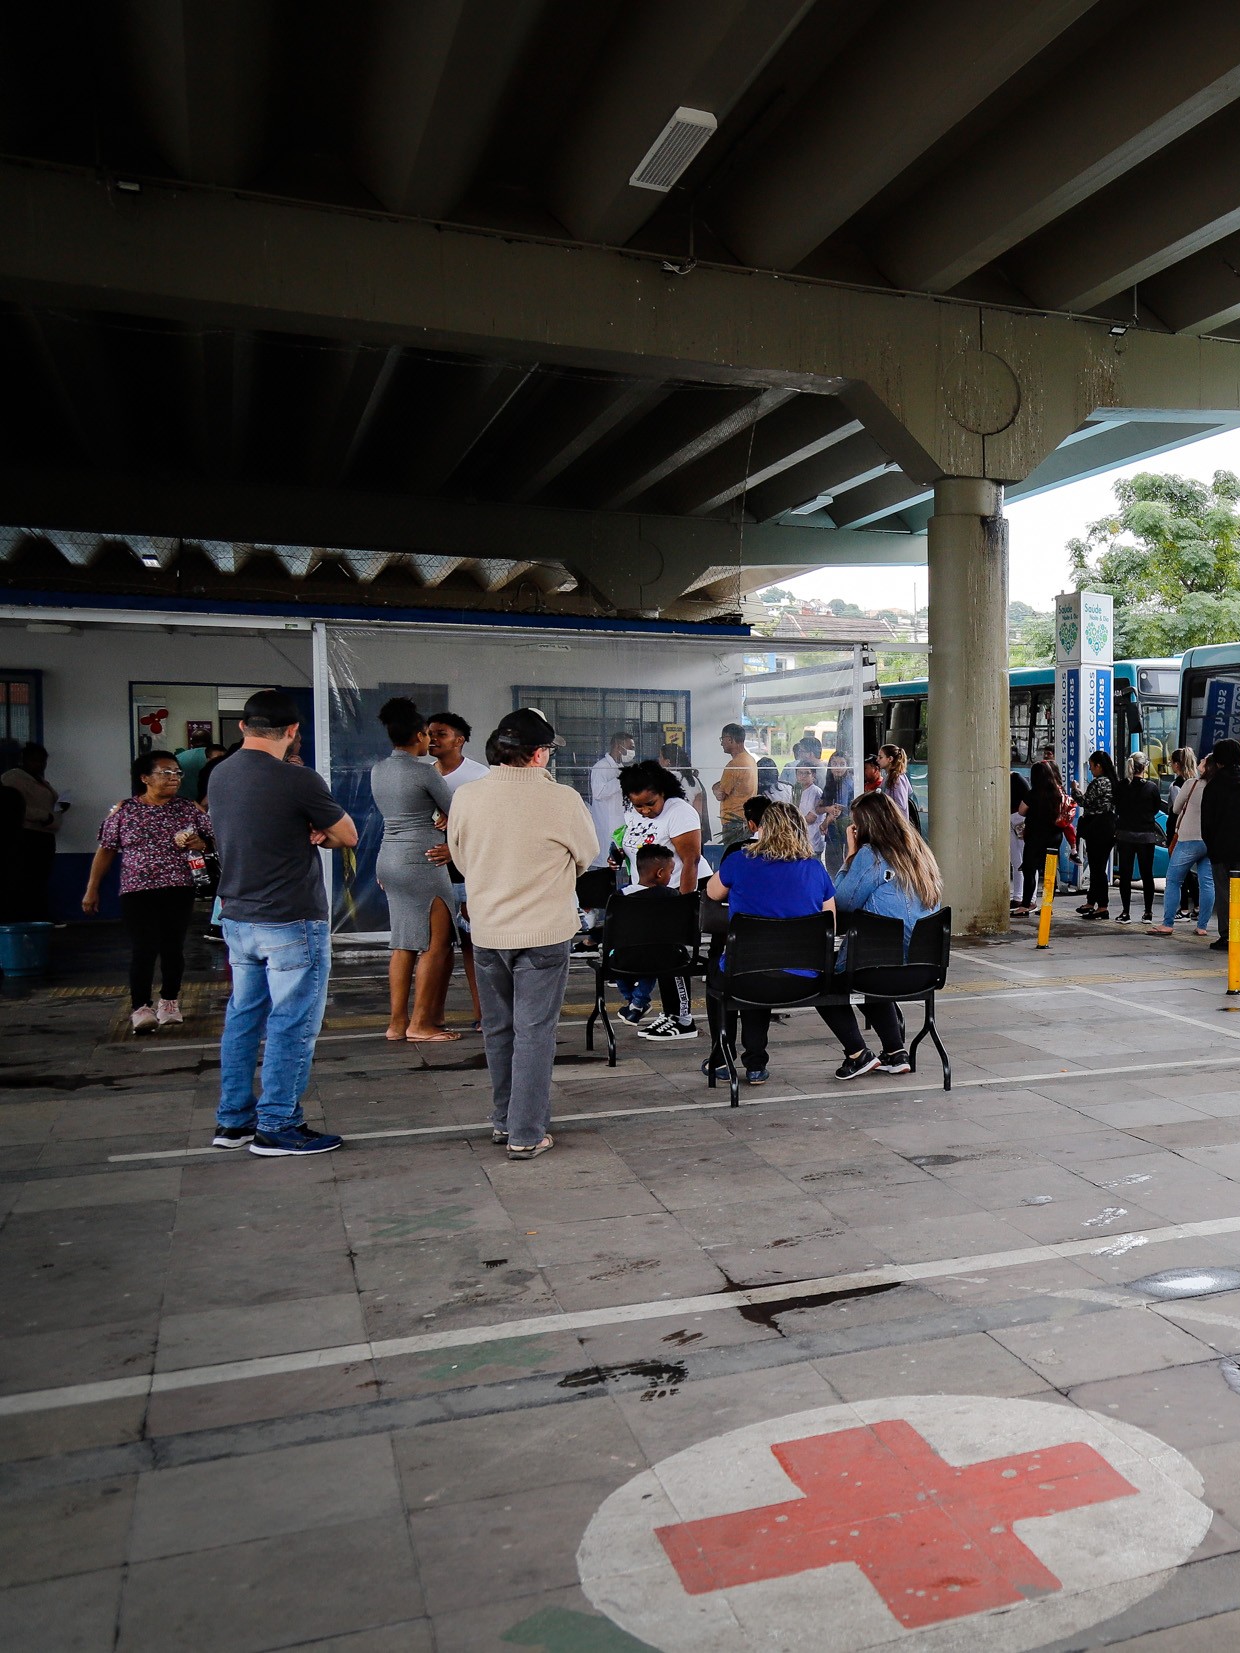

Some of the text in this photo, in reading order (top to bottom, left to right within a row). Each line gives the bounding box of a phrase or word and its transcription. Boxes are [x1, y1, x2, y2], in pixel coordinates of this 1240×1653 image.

[1058, 602, 1073, 614] Saúde
[1084, 602, 1102, 614] Saúde
[1068, 720, 1075, 737] 22
[1098, 720, 1105, 737] 22
